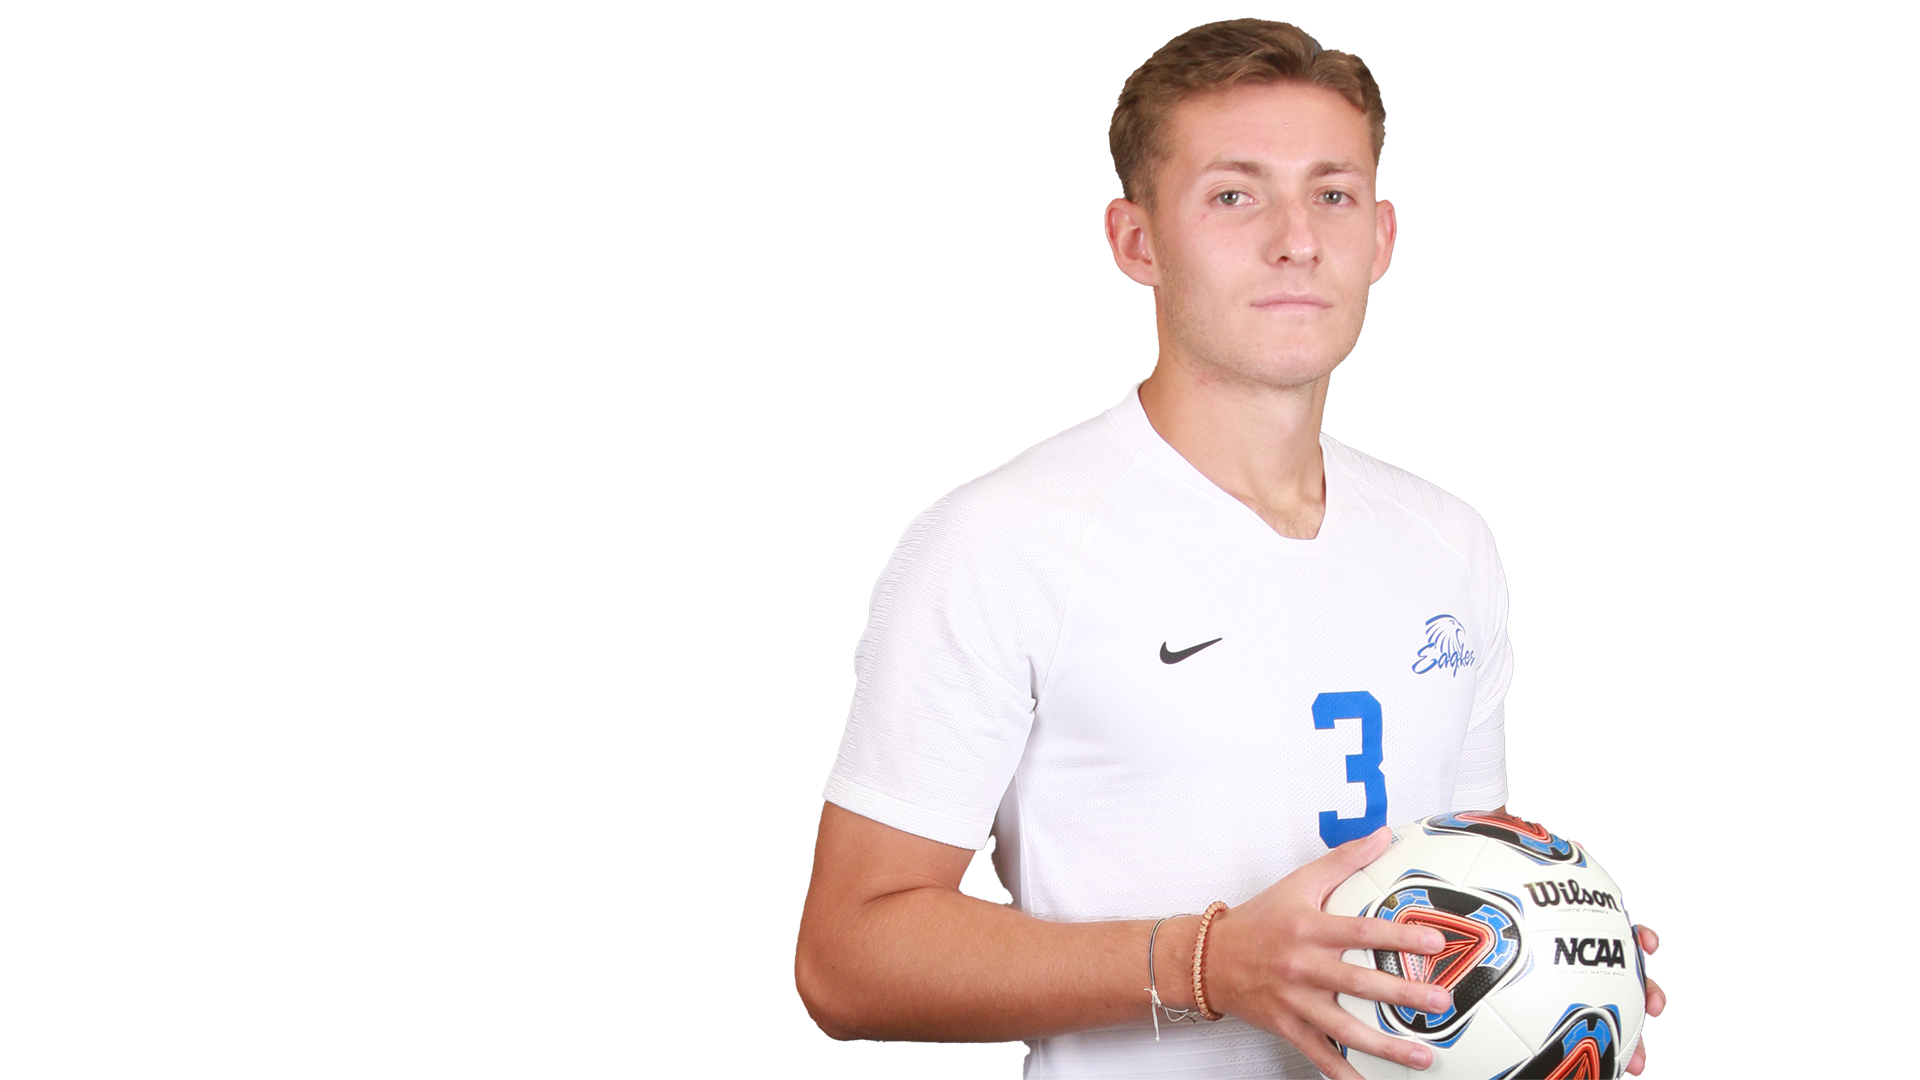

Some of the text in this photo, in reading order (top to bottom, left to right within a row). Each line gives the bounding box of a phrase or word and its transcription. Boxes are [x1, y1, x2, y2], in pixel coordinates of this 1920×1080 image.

[1411, 642, 1476, 678] Eagles
[1311, 690, 1388, 850] 3
[1522, 879, 1622, 913] Wilson
[1553, 937, 1626, 969] NCAA
